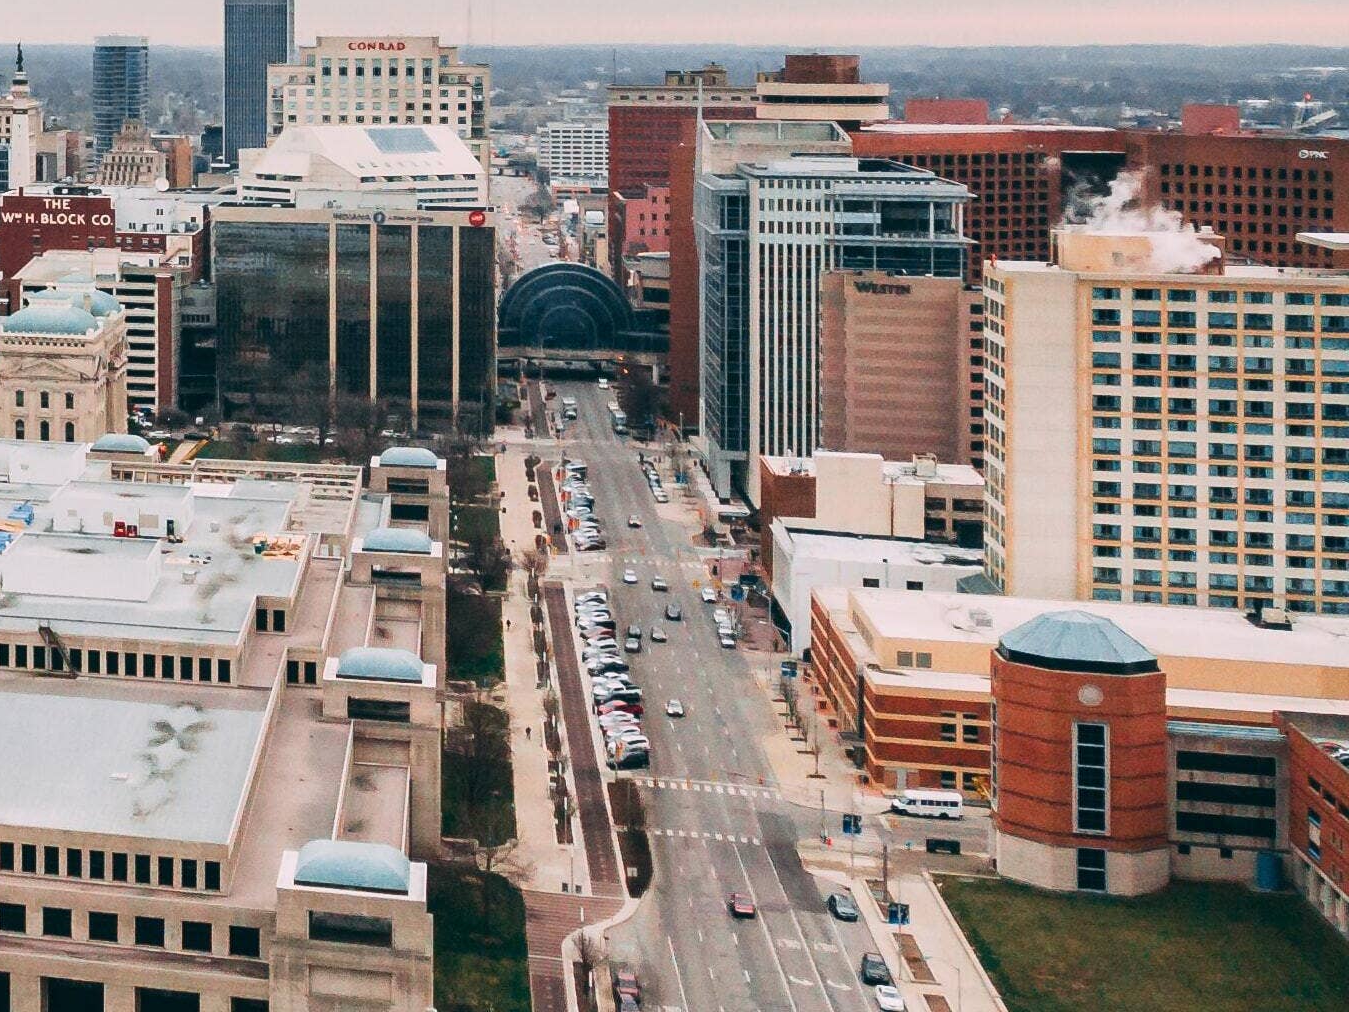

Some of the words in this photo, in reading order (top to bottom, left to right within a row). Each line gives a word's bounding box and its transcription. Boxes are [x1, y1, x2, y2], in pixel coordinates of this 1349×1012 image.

[348, 42, 406, 51] CONRAD
[1309, 150, 1330, 158] PNC
[43, 199, 71, 210] THE
[25, 213, 39, 224] H.
[41, 213, 85, 225] BLOCK
[91, 214, 114, 226] CO.
